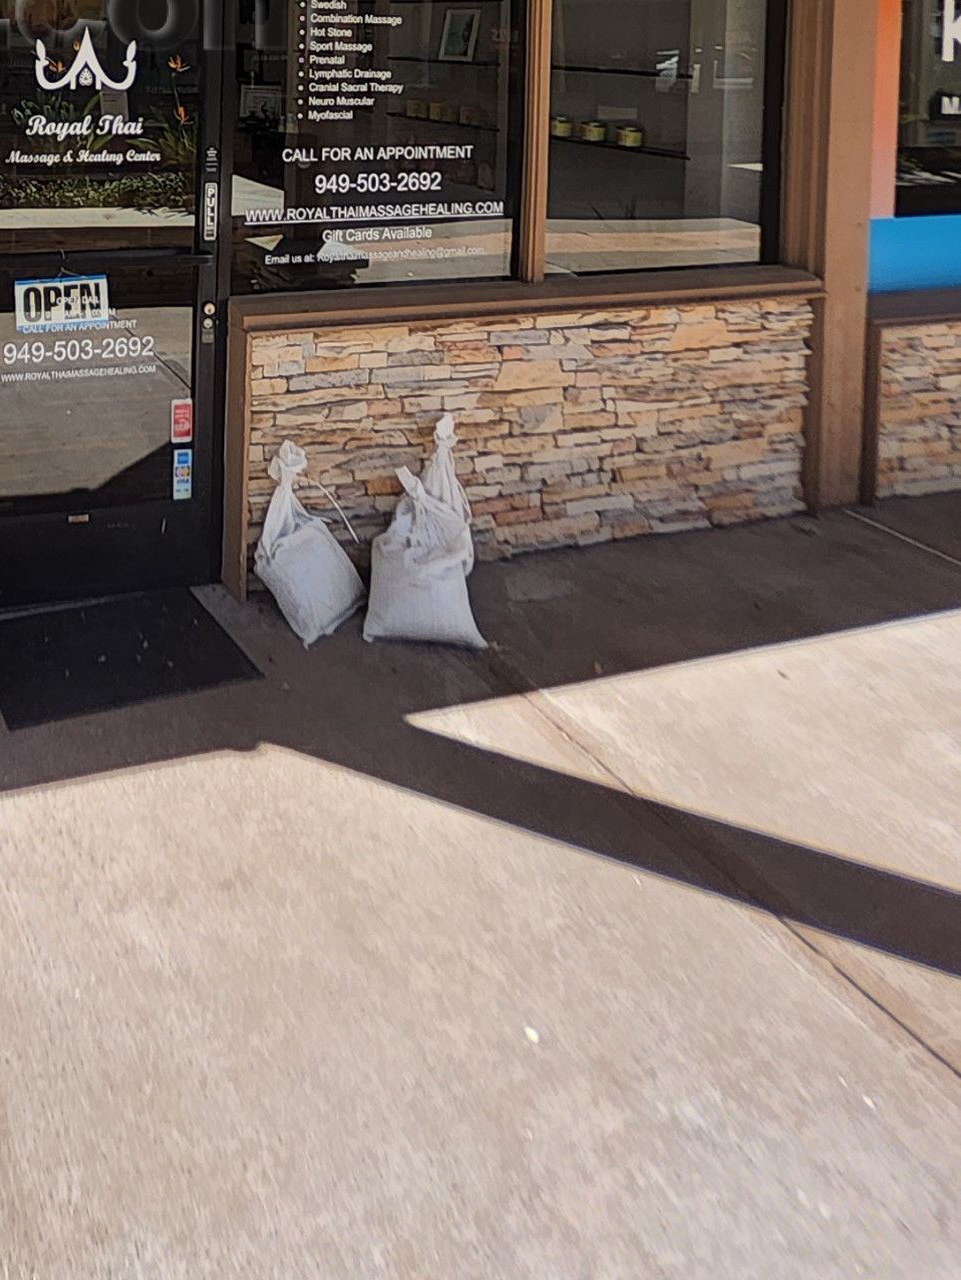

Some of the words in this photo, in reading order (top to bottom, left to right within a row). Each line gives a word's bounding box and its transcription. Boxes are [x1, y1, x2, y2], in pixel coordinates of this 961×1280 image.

[310, 0, 347, 10] Swedish
[310, 13, 363, 24] Combination
[364, 14, 403, 26] Massage
[310, 27, 326, 37] Hot
[327, 27, 353, 38] Stone
[309, 41, 333, 52] Sport
[334, 41, 373, 53] Massage
[309, 55, 346, 64] Prenatal
[308, 69, 353, 80] Lymphatic
[354, 69, 392, 81] Drainage
[308, 82, 339, 92] Cranial
[341, 82, 368, 92] Sacral
[369, 82, 404, 95] Therapy
[308, 96, 335, 106] Neuro
[336, 96, 375, 106] Muscular
[308, 110, 354, 122] Myofascial
[25, 114, 92, 141] Royal
[95, 114, 144, 136] Thai
[5, 150, 61, 166] Massage
[62, 150, 74, 163] &
[76, 149, 124, 166] Healing
[126, 149, 161, 162] Center
[282, 148, 318, 163] CALL
[321, 147, 352, 162] FOR
[354, 146, 374, 161] AN
[376, 145, 474, 161] APPOINTMENT
[314, 171, 442, 195] 949-503-2692
[207, 188, 215, 226] PULL
[245, 201, 504, 223] WWW.ROYALTHAIMASSAGEHEALING.COM
[322, 228, 343, 243] Gift
[345, 227, 380, 242] Cards
[381, 226, 433, 240] Available
[265, 254, 290, 265] Email
[291, 255, 302, 264] us
[23, 283, 101, 322] OPEN
[23, 323, 44, 334] CALL
[46, 322, 61, 333] FOR
[62, 322, 78, 332] AN
[79, 319, 138, 332] APPOINTMENT
[3, 336, 155, 365] 949-503-2692
